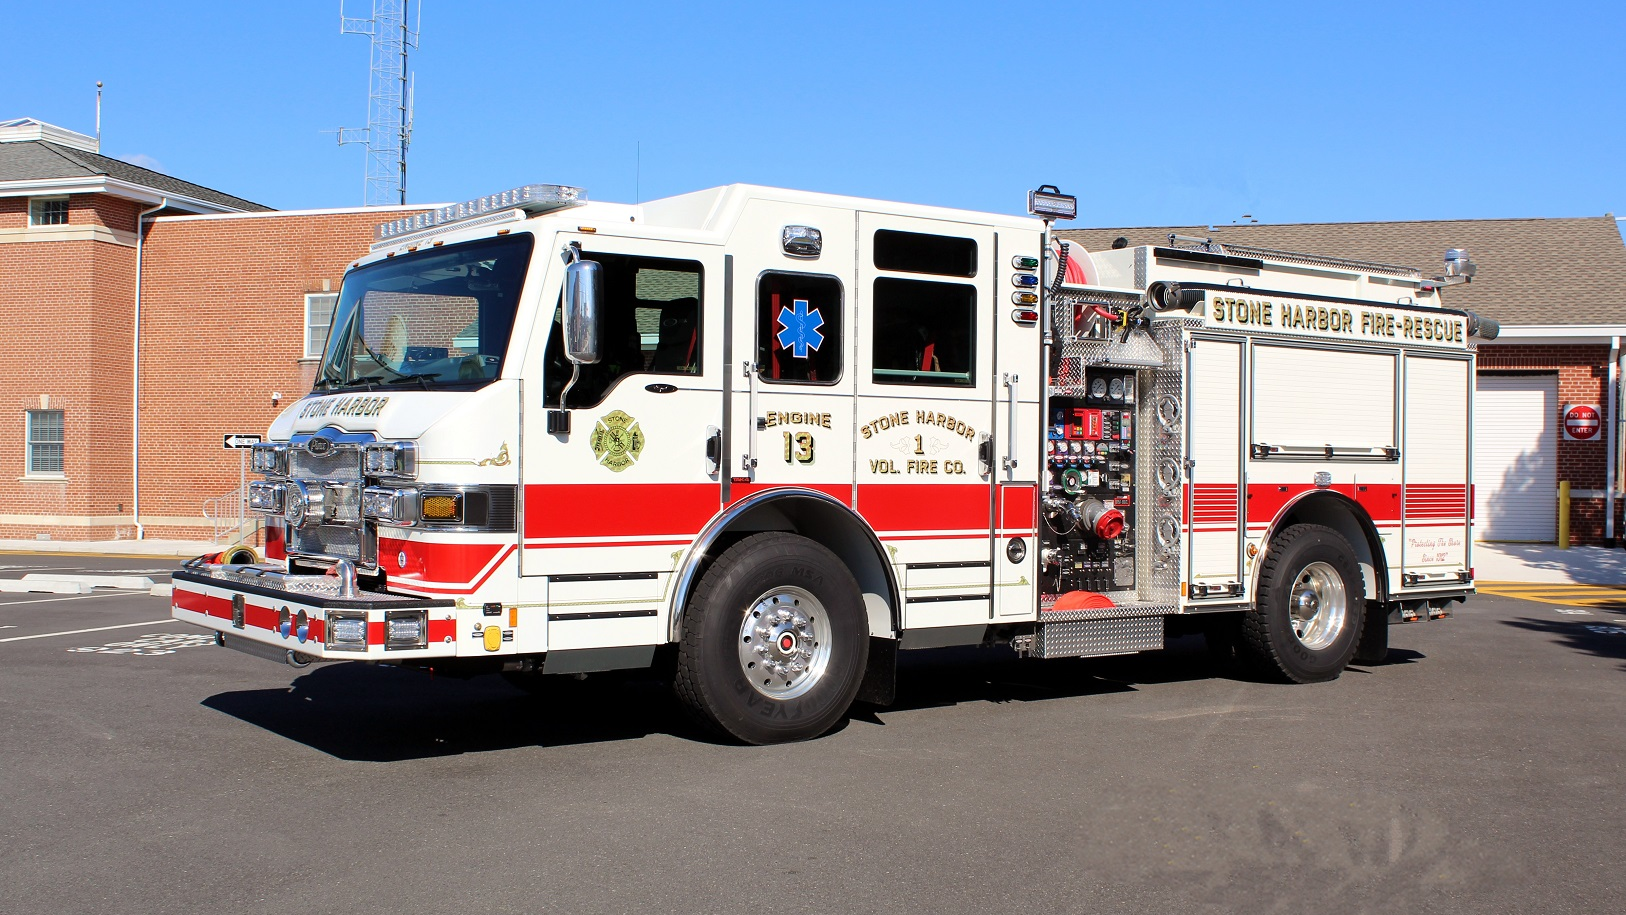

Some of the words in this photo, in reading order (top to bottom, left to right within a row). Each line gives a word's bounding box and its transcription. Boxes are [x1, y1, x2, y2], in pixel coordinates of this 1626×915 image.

[1213, 297, 1272, 326] STONE
[1281, 303, 1352, 333] HARBOR
[1360, 311, 1463, 342] FIRE-RESCUE
[299, 398, 336, 419] STONE
[331, 397, 390, 417] HARBOR
[607, 415, 628, 423] STONE
[766, 411, 832, 429] ENGINE
[860, 411, 909, 439] STONE
[915, 410, 975, 442] HARBOR
[783, 431, 815, 465] 13
[914, 434, 925, 455] 1
[604, 457, 629, 467] HARBOR
[869, 459, 901, 475] VOL.
[907, 459, 938, 475] FIRE
[944, 460, 966, 475] CO.
